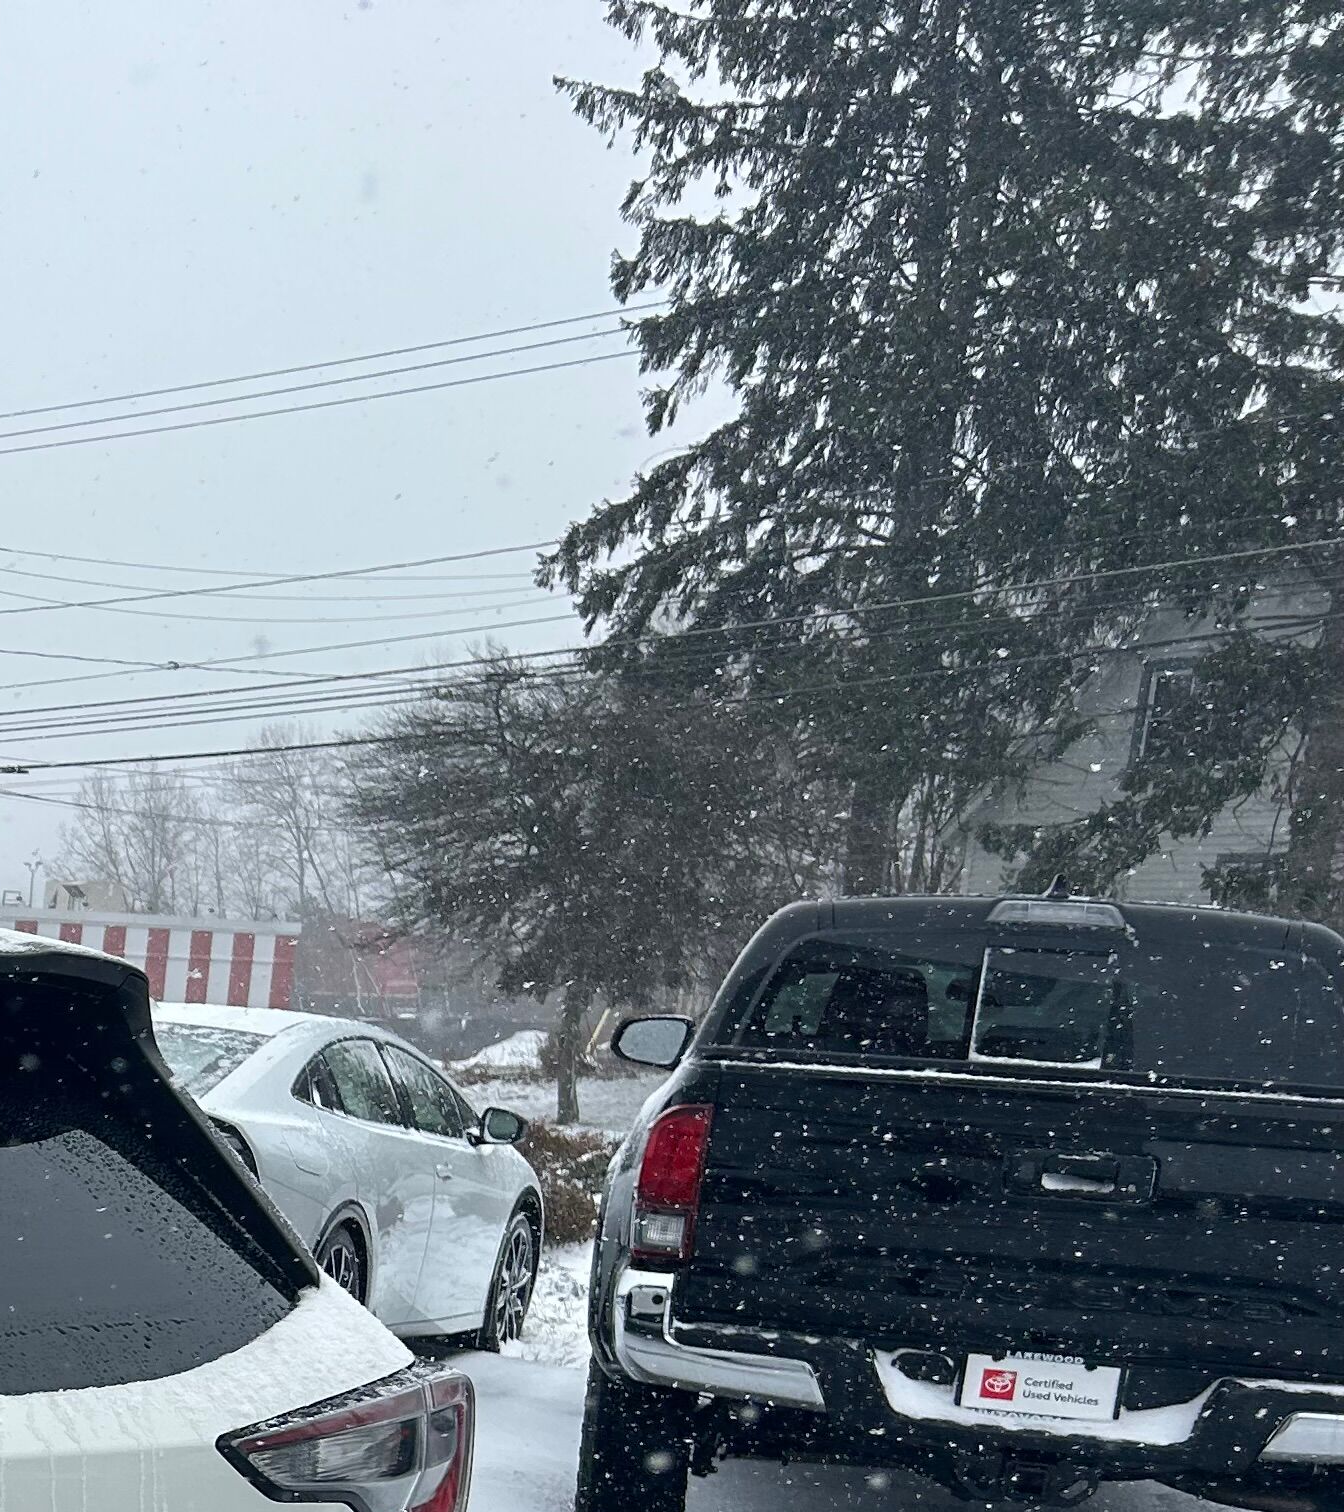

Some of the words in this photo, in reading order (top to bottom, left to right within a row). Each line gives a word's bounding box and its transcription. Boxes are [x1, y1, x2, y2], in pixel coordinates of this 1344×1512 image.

[1024, 1376, 1074, 1392] Certified
[1022, 1389, 1051, 1402] Used
[1053, 1393, 1099, 1406] Vehicles
